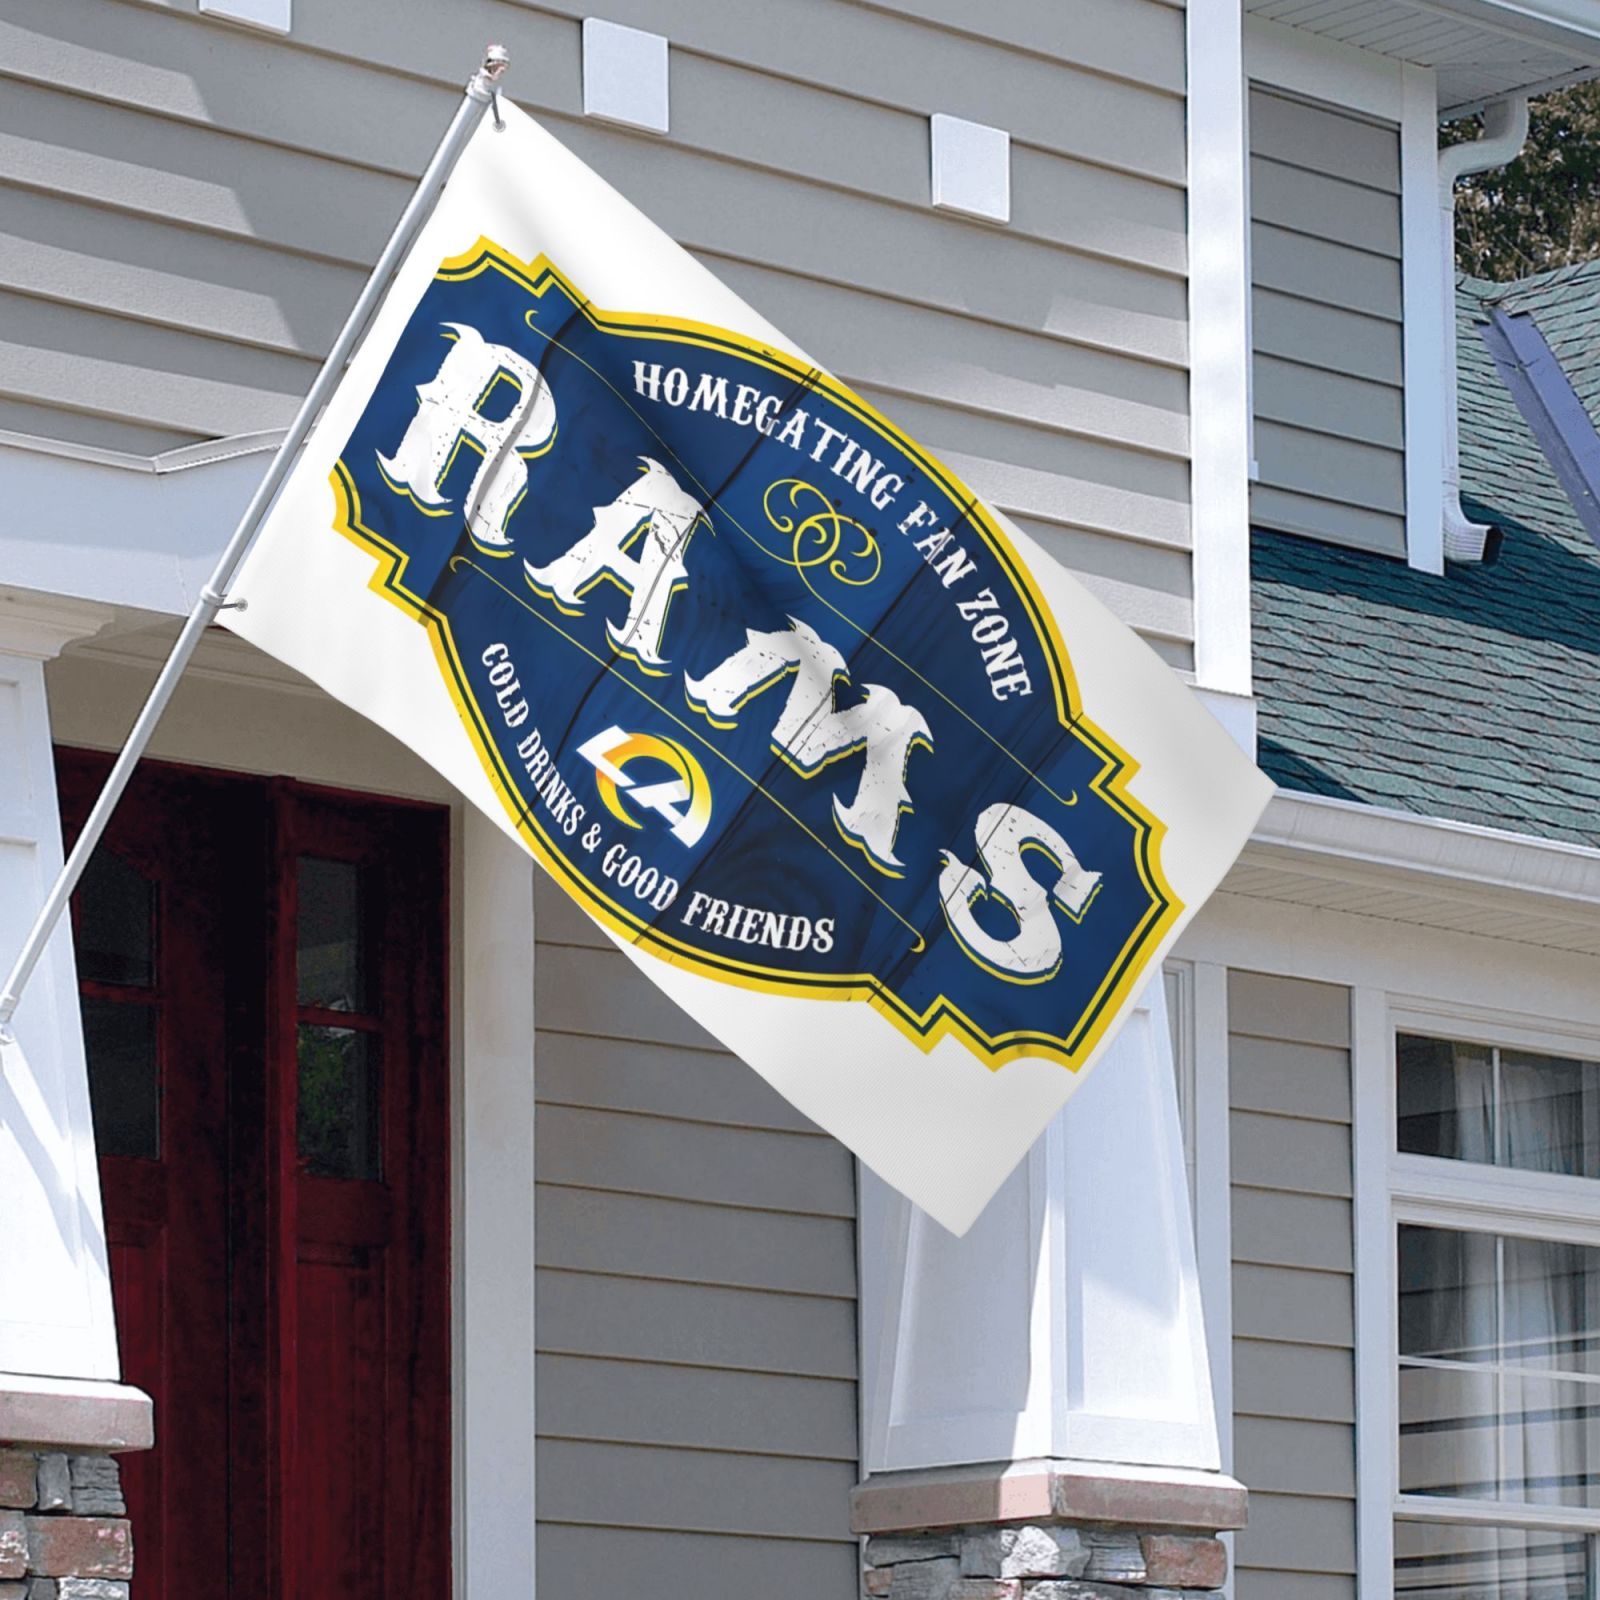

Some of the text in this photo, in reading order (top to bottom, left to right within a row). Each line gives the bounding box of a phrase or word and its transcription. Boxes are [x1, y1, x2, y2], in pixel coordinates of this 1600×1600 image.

[376, 322, 1103, 983] RAMS
[631, 360, 1034, 702] HOMEGATING FAN ZONE
[481, 642, 835, 953] COLD DRINKS & GOOD FRIENDS
